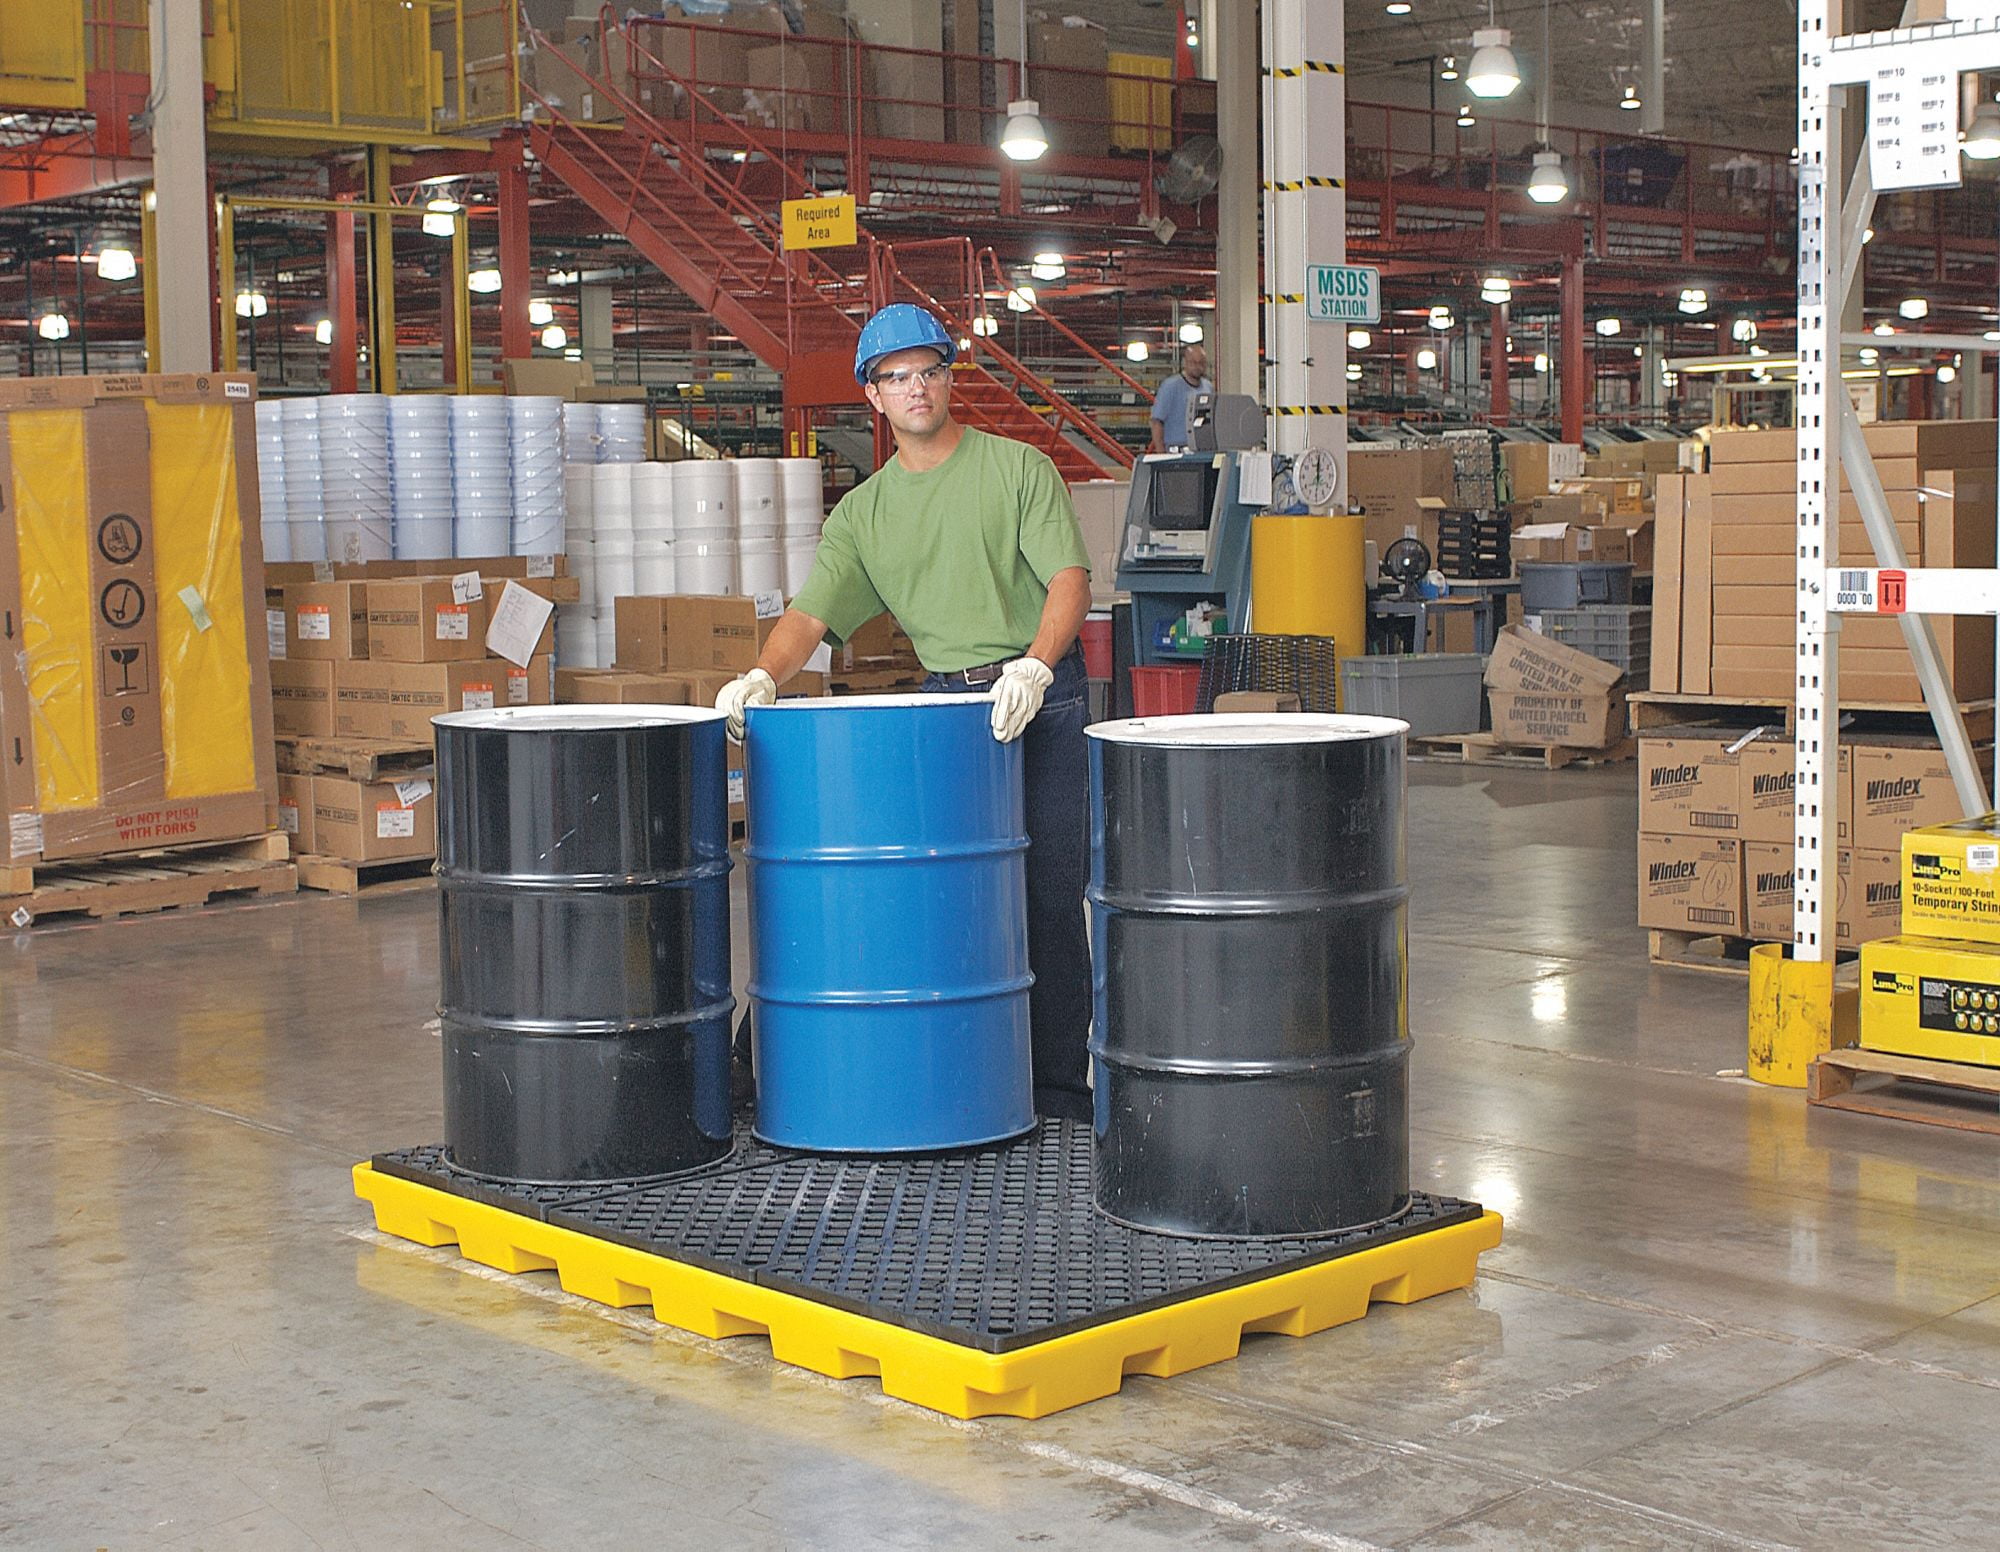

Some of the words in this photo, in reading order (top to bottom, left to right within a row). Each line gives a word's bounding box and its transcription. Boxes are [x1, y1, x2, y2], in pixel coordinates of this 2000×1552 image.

[1895, 67, 1905, 77] 10
[1940, 75, 1945, 84] 9
[1895, 92, 1900, 101] 8
[1940, 100, 1945, 109] 7
[1894, 116, 1900, 125] 6
[1940, 122, 1945, 131] 5
[1894, 138, 1900, 147] 4
[1940, 145, 1945, 154] 3
[1896, 160, 1901, 170] 2
[1942, 169, 1947, 179] 1
[796, 205, 840, 223] Required
[807, 226, 830, 240] Area
[1318, 269, 1369, 297] MSDS
[1321, 298, 1367, 316] STATION
[1509, 656, 1545, 682] UNITED
[1519, 647, 1569, 678] PROPERTY
[1570, 671, 1584, 685] OF
[1514, 696, 1567, 709] PROPERTY
[1570, 698, 1583, 710] OF
[1509, 708, 1546, 721] UNITED
[1549, 709, 1587, 723] PARCEL
[1526, 723, 1569, 736] SERVICE
[1650, 764, 1699, 787] Windex
[1753, 771, 1795, 794] Winde
[1867, 777, 1921, 801] Windex
[115, 815, 132, 828] DO
[137, 811, 161, 825] NOT
[166, 807, 198, 821] PUSH
[120, 826, 151, 840] WITH
[155, 821, 196, 836] FORKS
[1649, 859, 1696, 882] Windex
[1912, 863, 1960, 877] LumaPro
[1757, 870, 1795, 893] Wind
[1912, 882, 1952, 895] 10-Socket
[1866, 880, 1902, 902] Wind
[1912, 893, 1968, 912] Temporary
[1971, 899, 2000, 914] Strin
[1873, 979, 1913, 992] LumaPro
